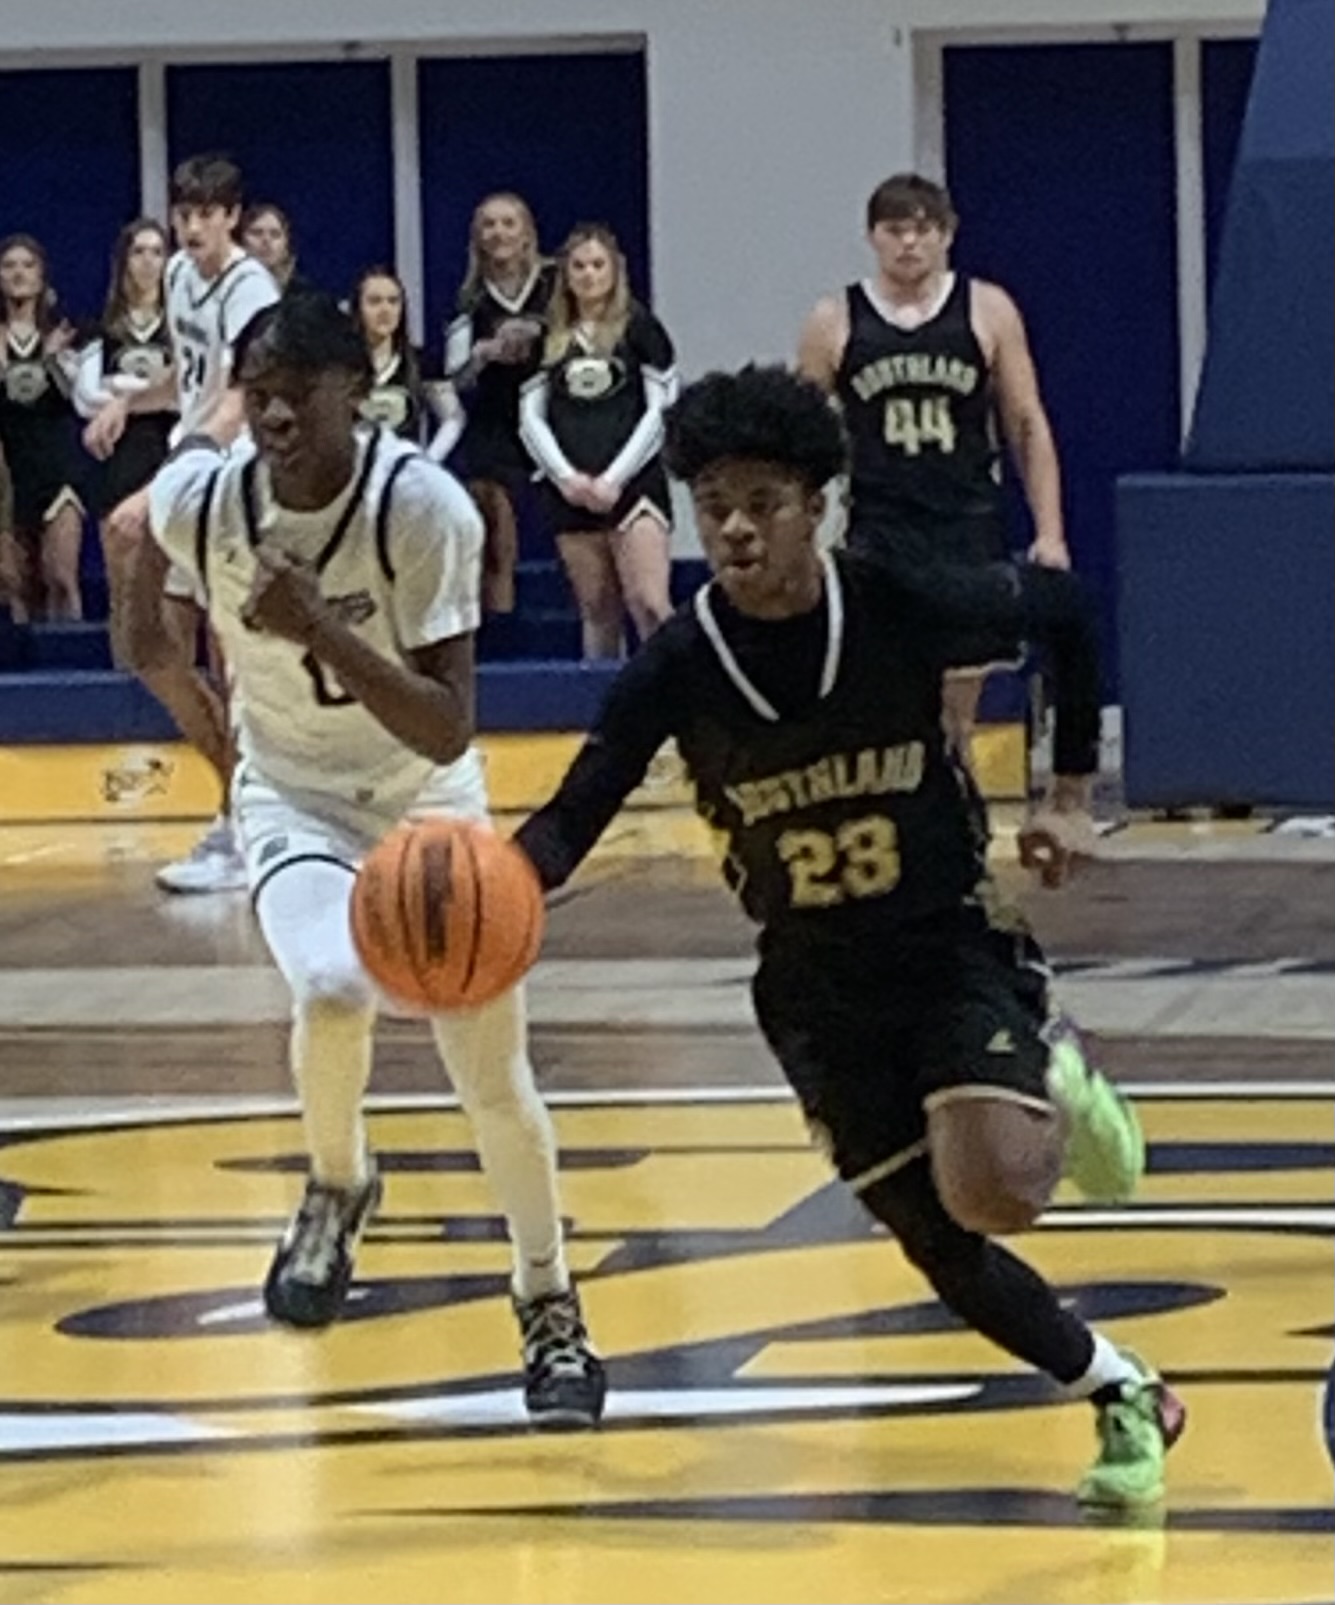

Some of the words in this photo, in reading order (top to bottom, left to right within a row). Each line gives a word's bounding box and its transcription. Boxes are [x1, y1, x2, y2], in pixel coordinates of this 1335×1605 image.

[851, 353, 977, 401] SOUTHLAND
[885, 397, 956, 455] 44
[775, 813, 901, 908] 23
